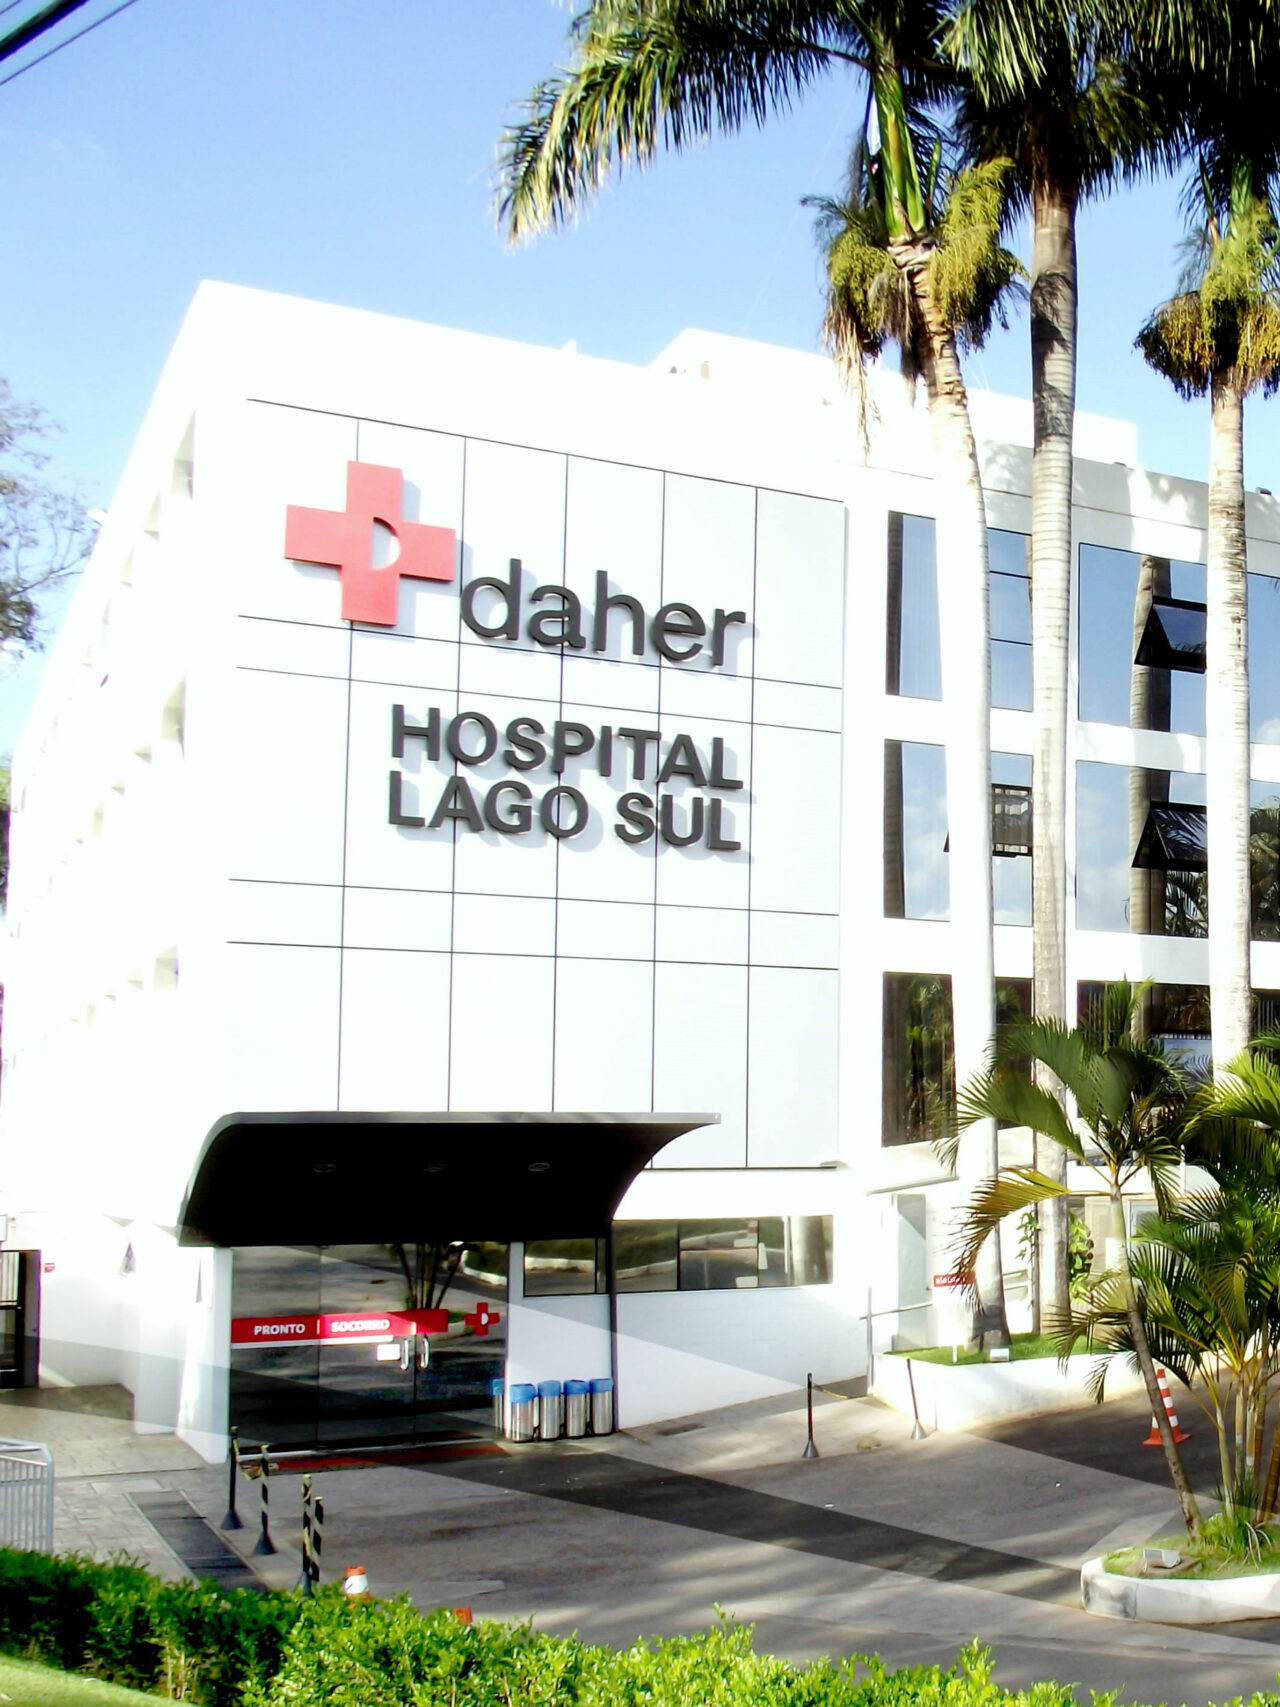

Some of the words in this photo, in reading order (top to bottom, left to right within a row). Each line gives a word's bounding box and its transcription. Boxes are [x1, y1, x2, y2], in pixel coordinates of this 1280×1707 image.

[460, 557, 747, 667] daher
[390, 703, 744, 790] HOSPITAL
[387, 770, 590, 839] LAGO
[613, 791, 742, 851] SUL
[253, 1323, 306, 1336] PRONTO
[330, 1318, 391, 1333] SOCORRO
